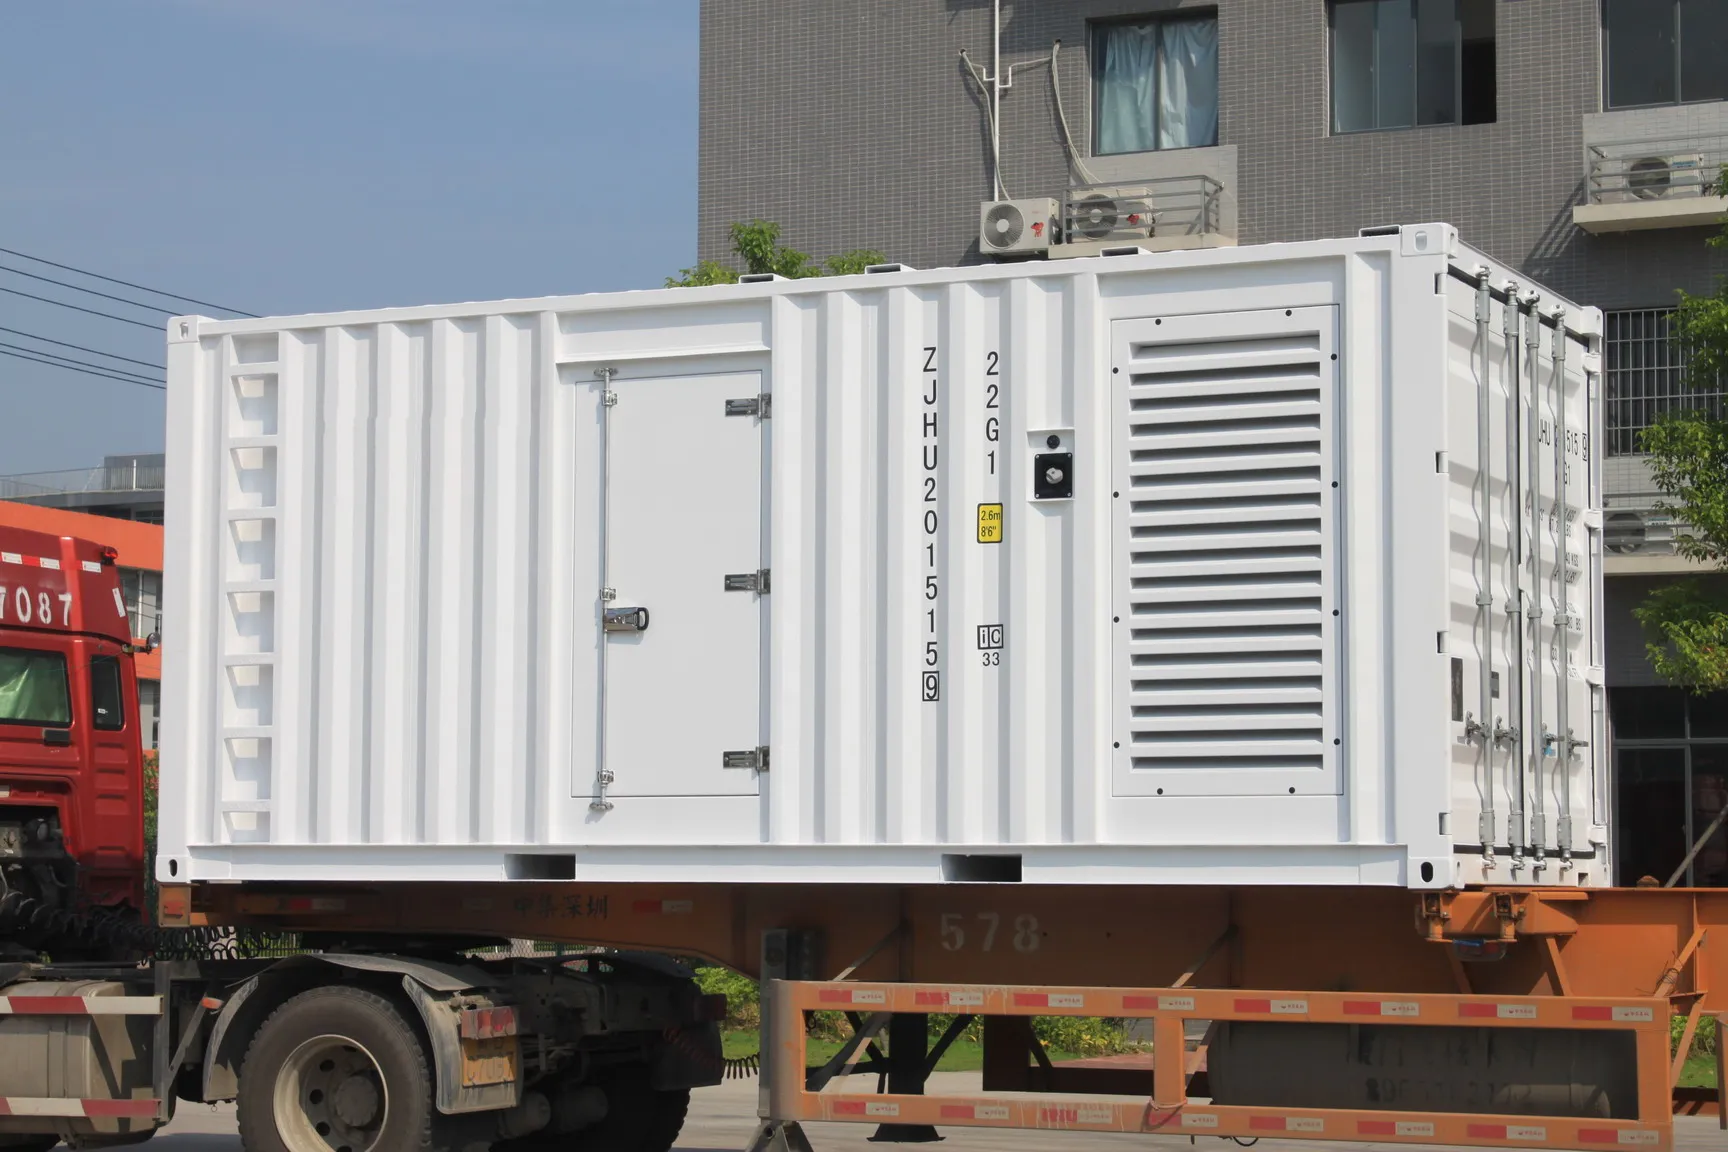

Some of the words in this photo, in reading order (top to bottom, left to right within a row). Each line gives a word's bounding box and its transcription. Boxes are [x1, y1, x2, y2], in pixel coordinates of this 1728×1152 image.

[985, 350, 999, 475] 22G1
[980, 509, 1001, 521] 2.6m
[980, 525, 997, 537] 8'6"
[982, 652, 1000, 667] 33
[940, 911, 1040, 953] 578
